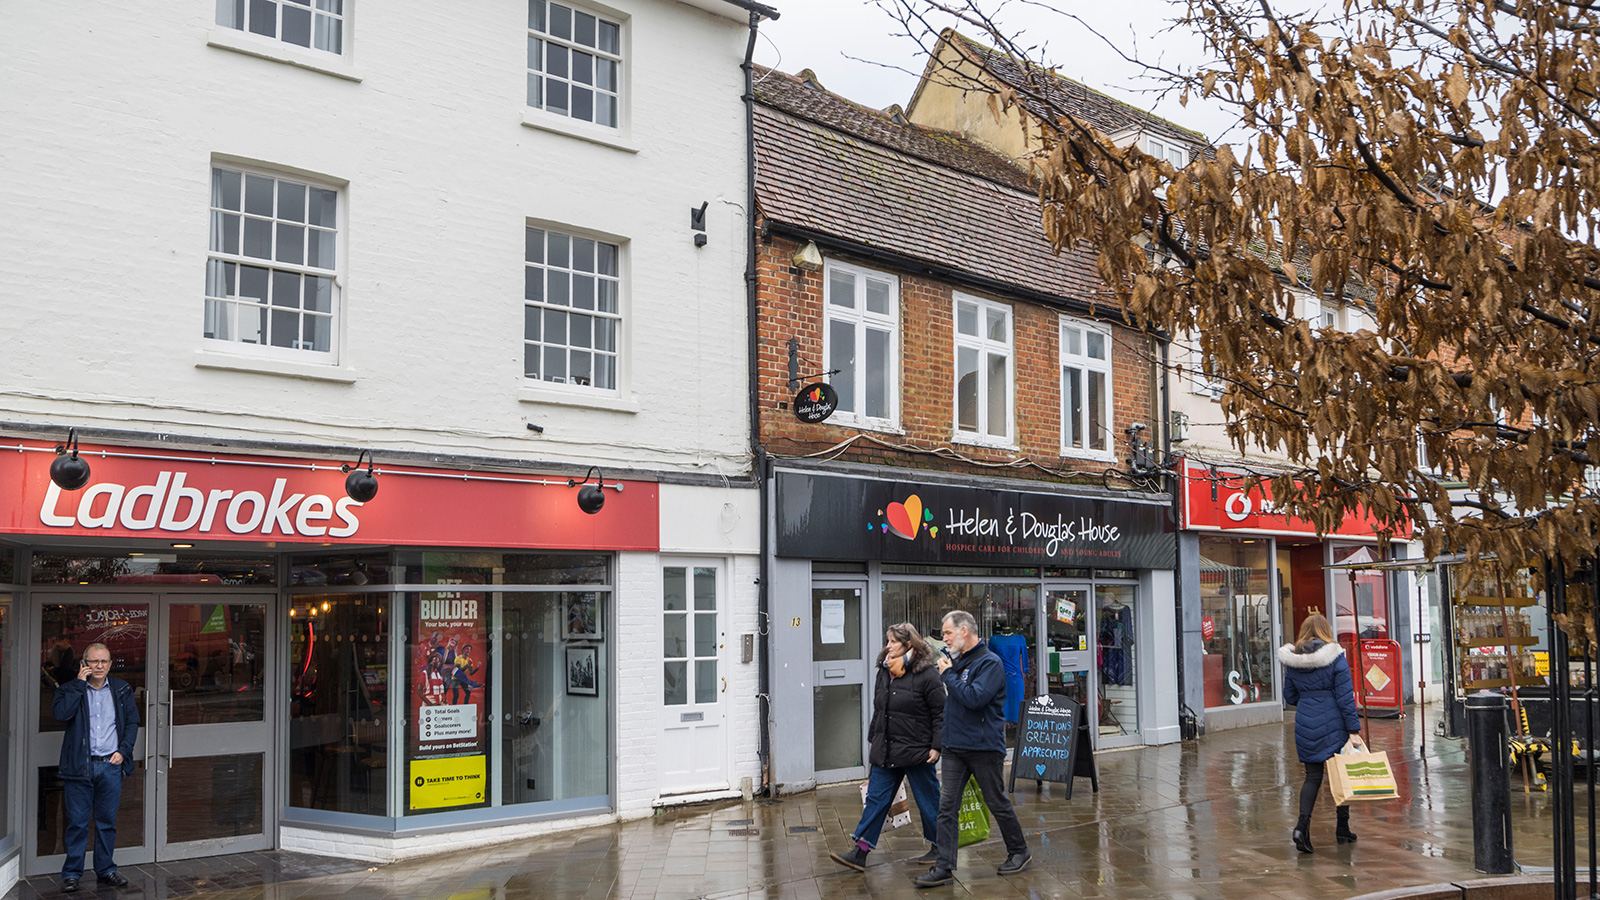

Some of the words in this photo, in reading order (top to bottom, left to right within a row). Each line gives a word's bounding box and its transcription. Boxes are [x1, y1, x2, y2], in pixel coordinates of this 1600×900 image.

[40, 471, 364, 538] Ladbrokes
[945, 507, 999, 537] Helen
[1005, 507, 1018, 545] &
[1020, 512, 1076, 557] Douglas
[1078, 516, 1121, 544] House
[946, 543, 976, 552] HOSPICE
[1012, 546, 1046, 555] CHILDREN
[1060, 548, 1074, 556] AND
[1076, 548, 1098, 557] YOUNG
[1100, 550, 1122, 558] ADULTS
[437, 579, 462, 598] BET
[420, 600, 478, 620] BUILDER
[791, 617, 801, 628] 13
[1027, 720, 1072, 731] DONATIONS
[1026, 731, 1070, 746] GREATLY
[1022, 746, 1069, 760] APPRECIATED
